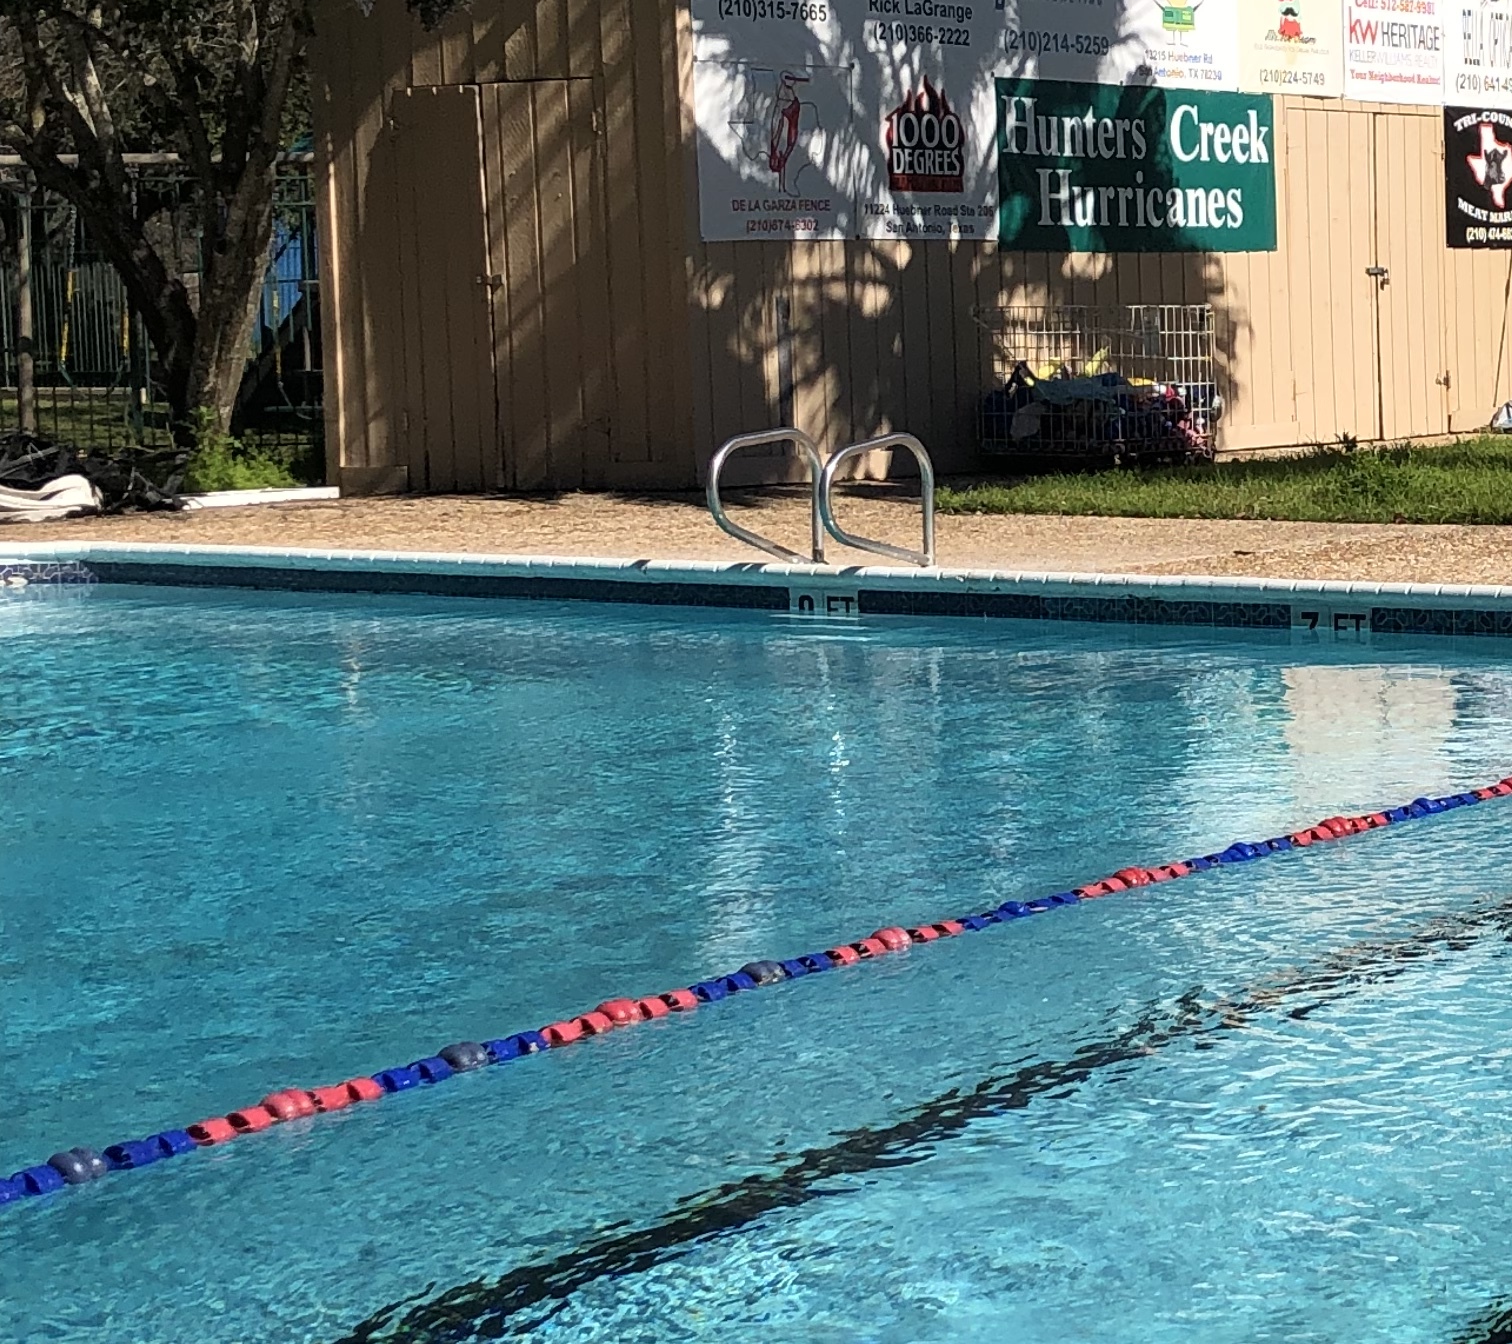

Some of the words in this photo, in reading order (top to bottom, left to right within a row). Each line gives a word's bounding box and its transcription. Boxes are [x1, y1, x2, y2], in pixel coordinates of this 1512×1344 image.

[873, 22, 970, 46] (210)366-2222
[1004, 29, 1109, 56] (210)214-5259
[1381, 21, 1440, 51] HERITAGE
[1260, 69, 1325, 86] (210)224-5749
[1456, 73, 1481, 94] (210)
[891, 113, 960, 148] 1000
[1001, 96, 1147, 160] Hunters
[1170, 104, 1270, 163] Creek
[892, 148, 961, 175] DEGREES
[732, 199, 746, 211] DE
[748, 199, 761, 211] LA
[763, 199, 796, 211] GARZA
[798, 199, 831, 211] FENCE
[934, 204, 958, 215] Road
[1035, 168, 1244, 229] Hurricanes
[1457, 197, 1488, 221] MEAT
[1334, 612, 1366, 632] FT
